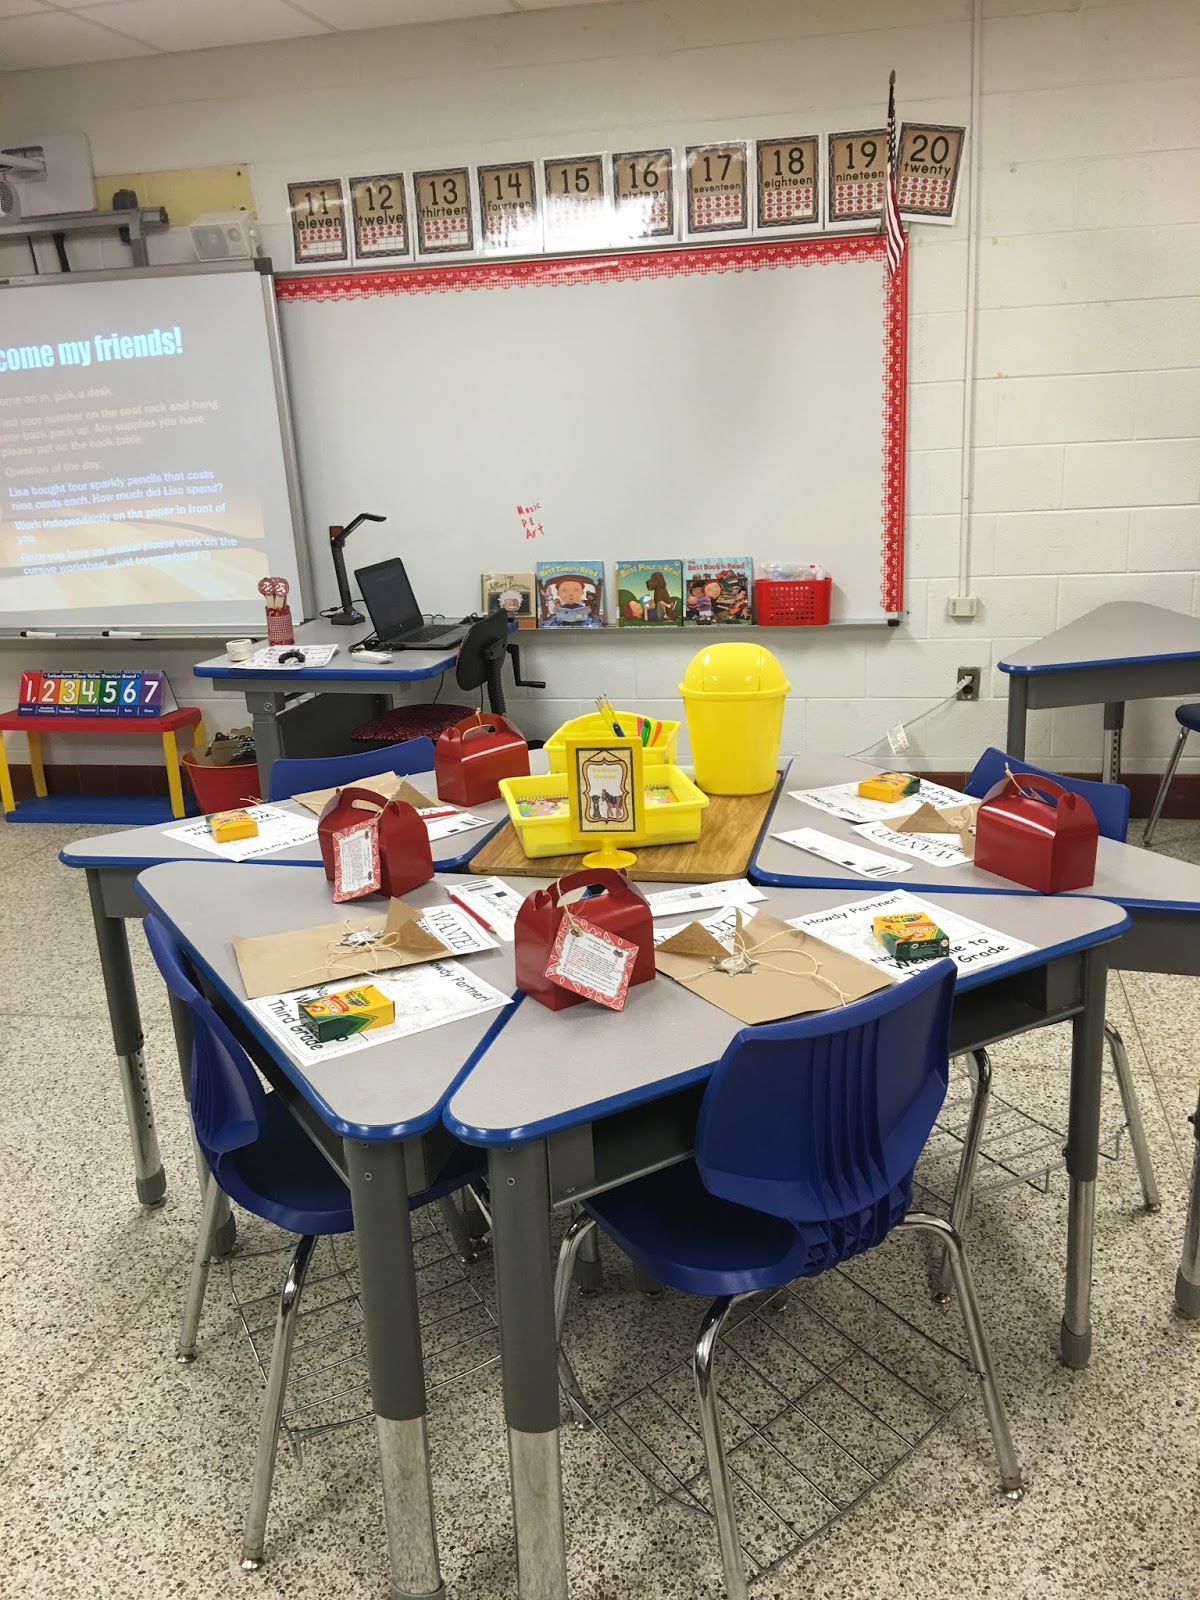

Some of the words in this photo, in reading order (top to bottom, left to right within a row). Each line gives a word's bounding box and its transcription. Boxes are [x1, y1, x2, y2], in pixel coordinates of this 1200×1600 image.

[773, 147, 805, 176] 18
[846, 140, 878, 170] 19
[909, 134, 950, 164] 20
[629, 161, 659, 188] 16
[703, 154, 732, 182] 17
[836, 169, 885, 182] nineteen
[904, 161, 952, 176] twenty
[429, 179, 457, 205] 13
[494, 173, 522, 201] 14
[561, 168, 590, 194] 15
[693, 182, 741, 194] seventeen
[765, 175, 813, 189] eighteen
[304, 191, 329, 216] 11
[367, 185, 394, 211] 12
[487, 201, 531, 212] fourteen
[298, 216, 341, 229] eleven
[357, 211, 404, 226] twelve
[421, 205, 468, 219] thirteen
[58, 342, 91, 367] my
[93, 326, 183, 361] friends!
[54, 390, 75, 404] pick
[45, 413, 83, 424] number
[86, 411, 99, 421] on
[101, 407, 118, 418] the
[119, 405, 142, 416] coat
[145, 402, 167, 414] rack
[170, 400, 190, 412] and
[191, 398, 219, 411] hang
[50, 426, 74, 440] pack
[115, 419, 156, 432] supplies
[159, 417, 178, 429] you
[179, 414, 205, 426] have
[1, 446, 35, 458] please
[37, 444, 54, 456] put
[55, 443, 69, 452] on
[71, 440, 88, 451] the
[89, 438, 114, 449] back
[5, 466, 50, 479] Question
[51, 463, 62, 474] of
[64, 461, 79, 472] the
[9, 486, 30, 498] Lisa
[31, 482, 66, 498] bought
[68, 481, 88, 492] four
[90, 476, 125, 492] sparkly
[127, 473, 162, 487] pencils
[164, 472, 185, 482] that
[187, 470, 214, 481] costs
[12, 500, 33, 511] nine
[35, 498, 62, 510] cents
[64, 496, 90, 507] each.
[93, 493, 114, 504] How
[116, 490, 144, 502] much
[146, 486, 162, 498] did
[163, 485, 184, 496] Lisa
[186, 482, 223, 497] spend?
[15, 519, 42, 531] Work
[43, 512, 111, 528] independently
[113, 512, 126, 521] on
[127, 509, 144, 519] the
[146, 506, 175, 519] paper
[176, 504, 186, 514] in
[188, 502, 213, 514] front
[215, 501, 226, 513] of
[526, 523, 544, 540] Art
[47, 550, 65, 562] you
[67, 548, 90, 559] have
[92, 548, 105, 557] an
[107, 543, 141, 556] answer
[144, 540, 175, 552] please
[177, 537, 203, 548] work
[204, 538, 218, 547] on
[220, 536, 238, 546] the
[23, 563, 57, 575] cursive
[540, 568, 556, 578] Best
[580, 566, 599, 577] Read
[620, 566, 637, 577] Best
[638, 563, 657, 572] Place
[664, 564, 680, 577] Read
[727, 562, 745, 570] Read
[42, 680, 56, 702] 2
[62, 680, 76, 702] 3
[102, 680, 118, 702] 5
[123, 680, 136, 703] 6
[144, 680, 159, 703] 7
[871, 829, 955, 860] WANTED
[803, 909, 848, 927] Howdy
[849, 895, 902, 914] Partner!
[894, 926, 935, 935] CRAYONS
[957, 944, 1010, 963] Grade
[968, 938, 989, 950] to
[427, 960, 452, 978] owdy
[454, 976, 491, 1003] Partner!
[268, 1000, 296, 1025] Third
[290, 1024, 325, 1051] Grade
